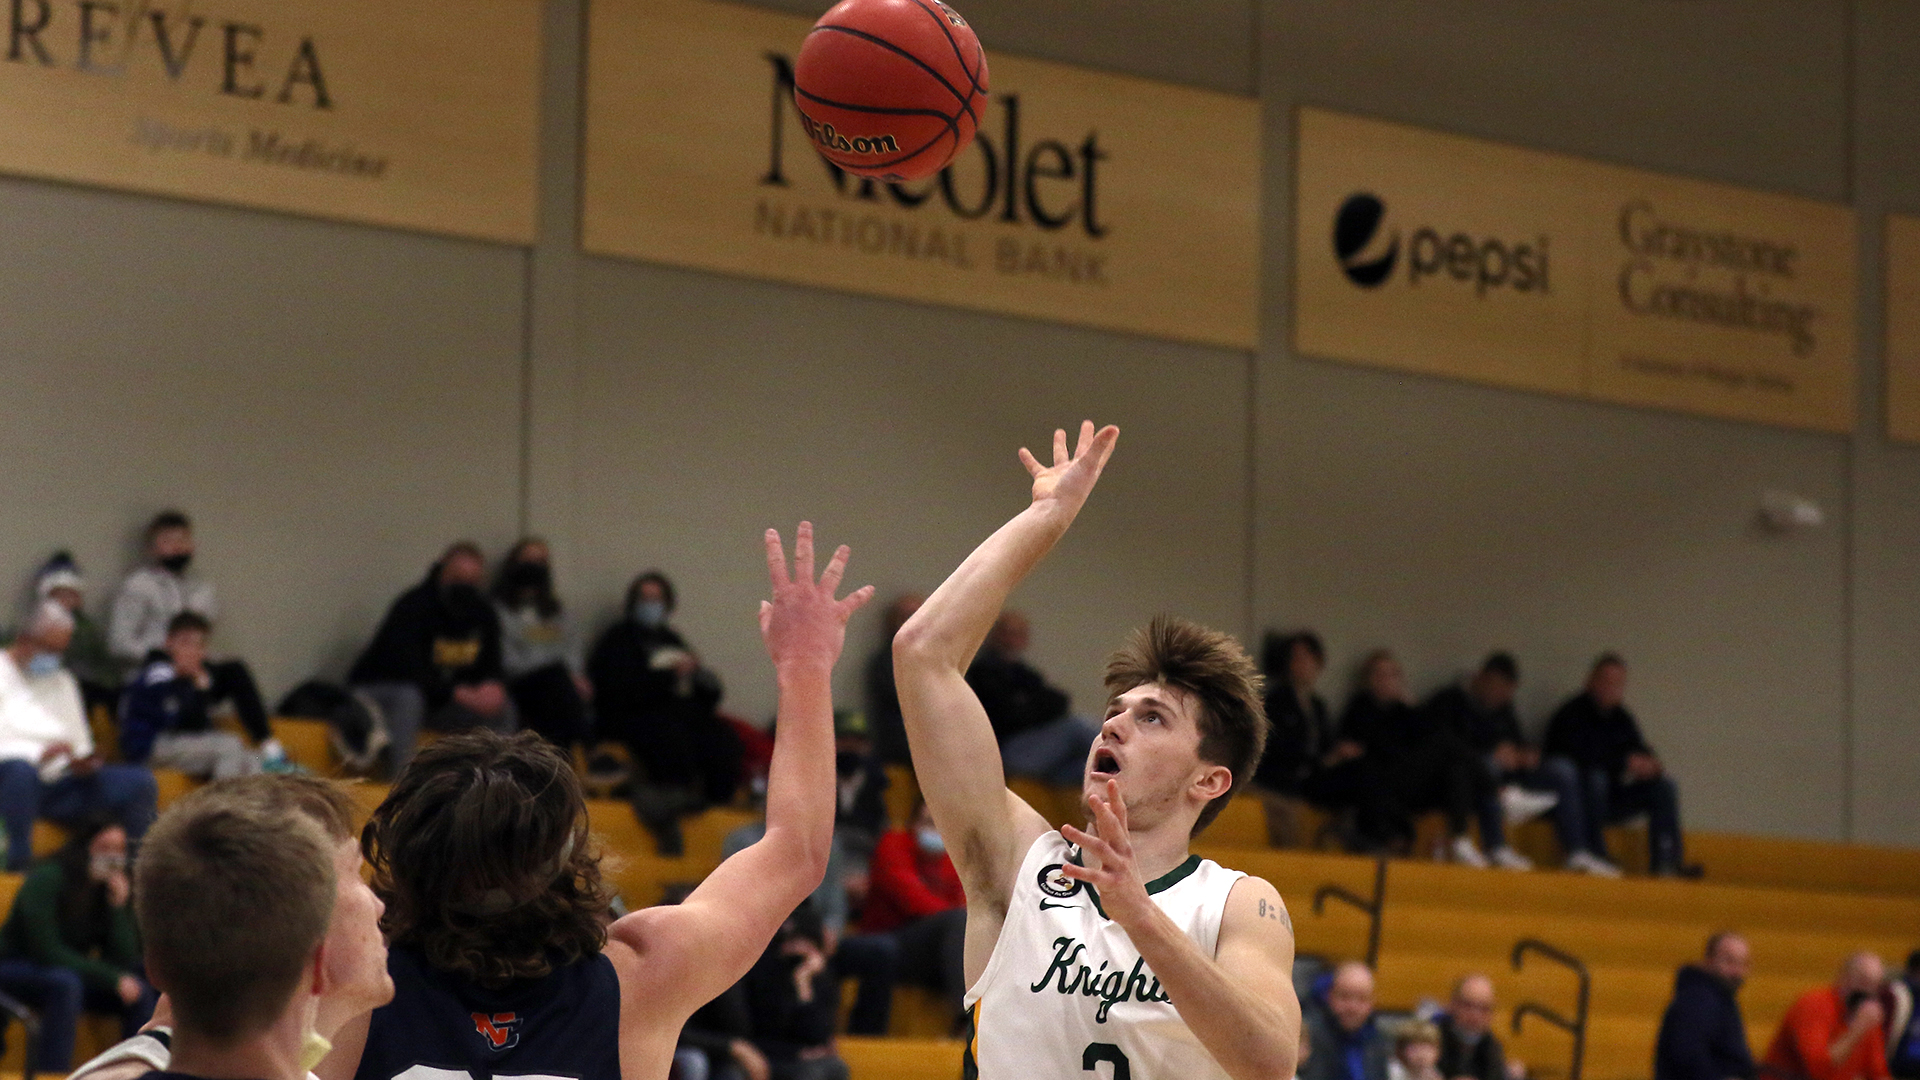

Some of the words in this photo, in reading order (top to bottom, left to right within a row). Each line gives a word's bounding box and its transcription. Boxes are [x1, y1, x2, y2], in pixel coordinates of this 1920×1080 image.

[758, 52, 1109, 239] Nolet
[752, 202, 977, 270] NATIONAL
[994, 234, 1109, 288] BANK
[1408, 225, 1552, 298] pepsi
[1617, 256, 1819, 358] Consulting
[1031, 936, 1172, 1023] Knight
